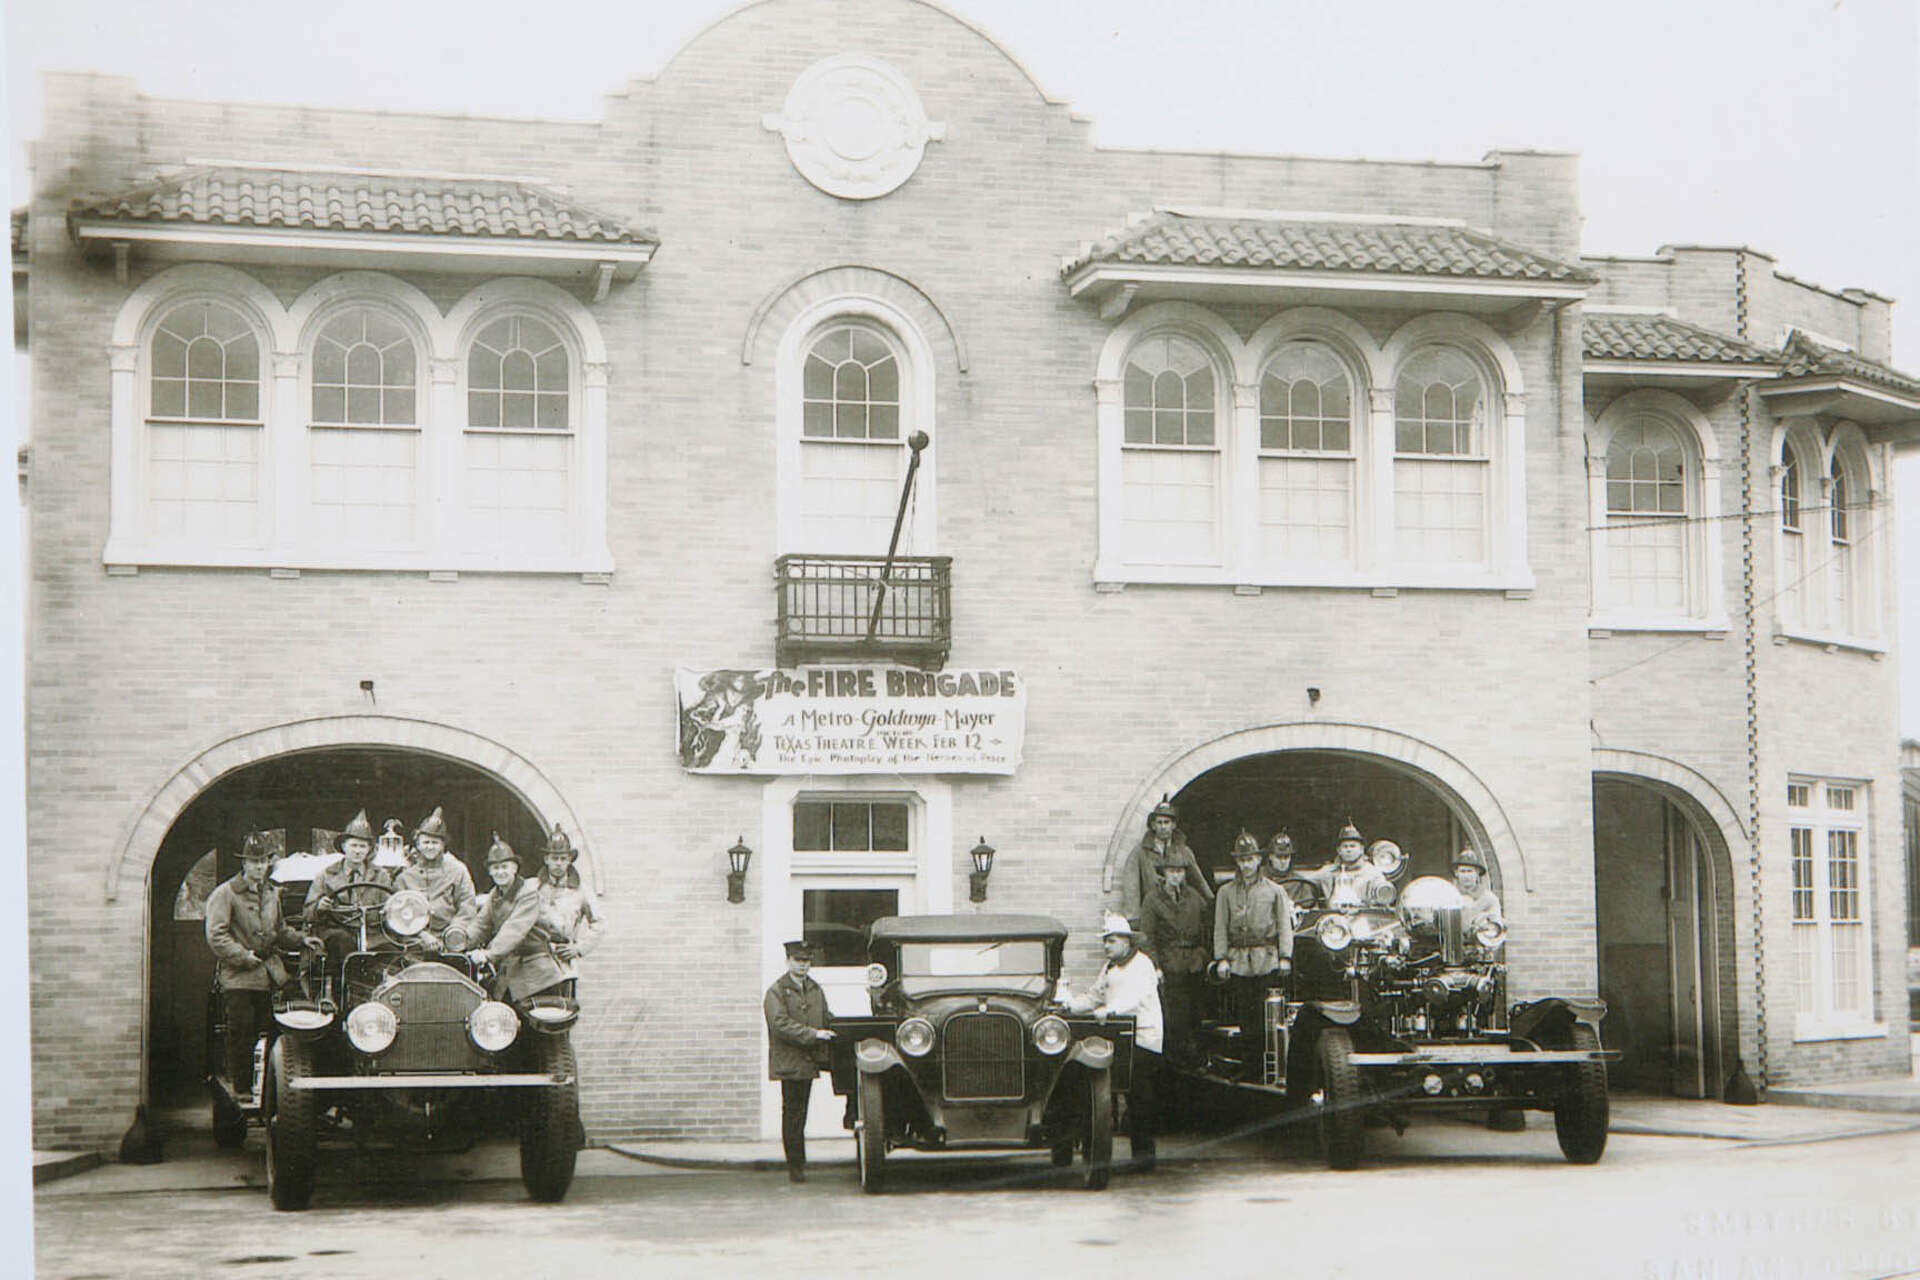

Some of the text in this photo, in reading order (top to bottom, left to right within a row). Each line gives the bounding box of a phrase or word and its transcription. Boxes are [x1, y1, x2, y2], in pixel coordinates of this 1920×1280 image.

[760, 670, 1016, 700] The FIRE BRIGADE
[965, 733, 982, 751] 12
